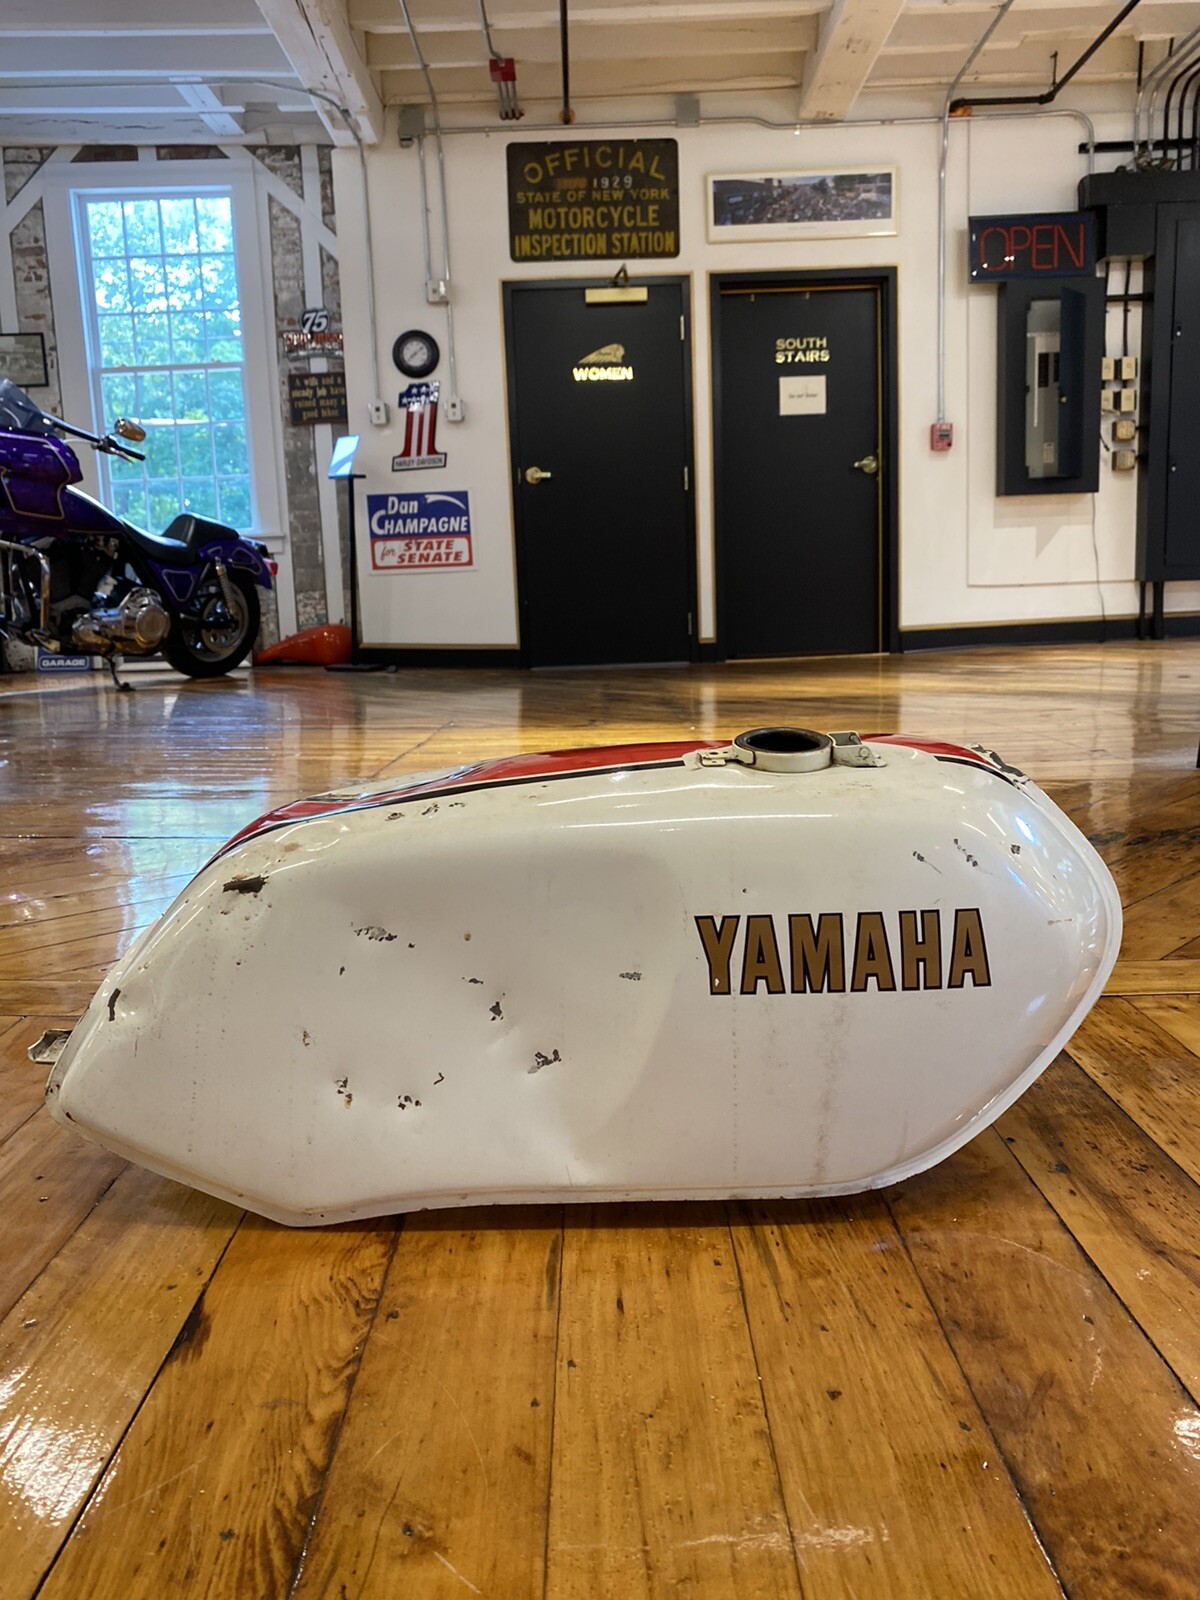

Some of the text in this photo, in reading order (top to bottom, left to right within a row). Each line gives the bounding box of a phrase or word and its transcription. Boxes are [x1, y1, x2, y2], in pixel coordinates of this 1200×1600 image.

[524, 146, 666, 184] OFFICIAL
[593, 175, 633, 189] 1929
[516, 188, 670, 204] STATE OF NEW YORK
[528, 205, 660, 230] MOTORCYCLE
[514, 231, 675, 257] INSPECTION STATION
[979, 223, 1085, 271] OPEN
[302, 310, 328, 333] 75
[775, 337, 827, 350] SOUTH
[775, 350, 830, 363] STAIRS
[572, 366, 634, 381] WOMEN
[387, 496, 418, 514] Dan
[371, 509, 468, 535] CHAMPAGNE
[404, 539, 455, 552] STATE
[380, 546, 463, 564] for SENATE
[42, 659, 86, 667] GARAGE
[694, 908, 992, 995] YAMAHA
